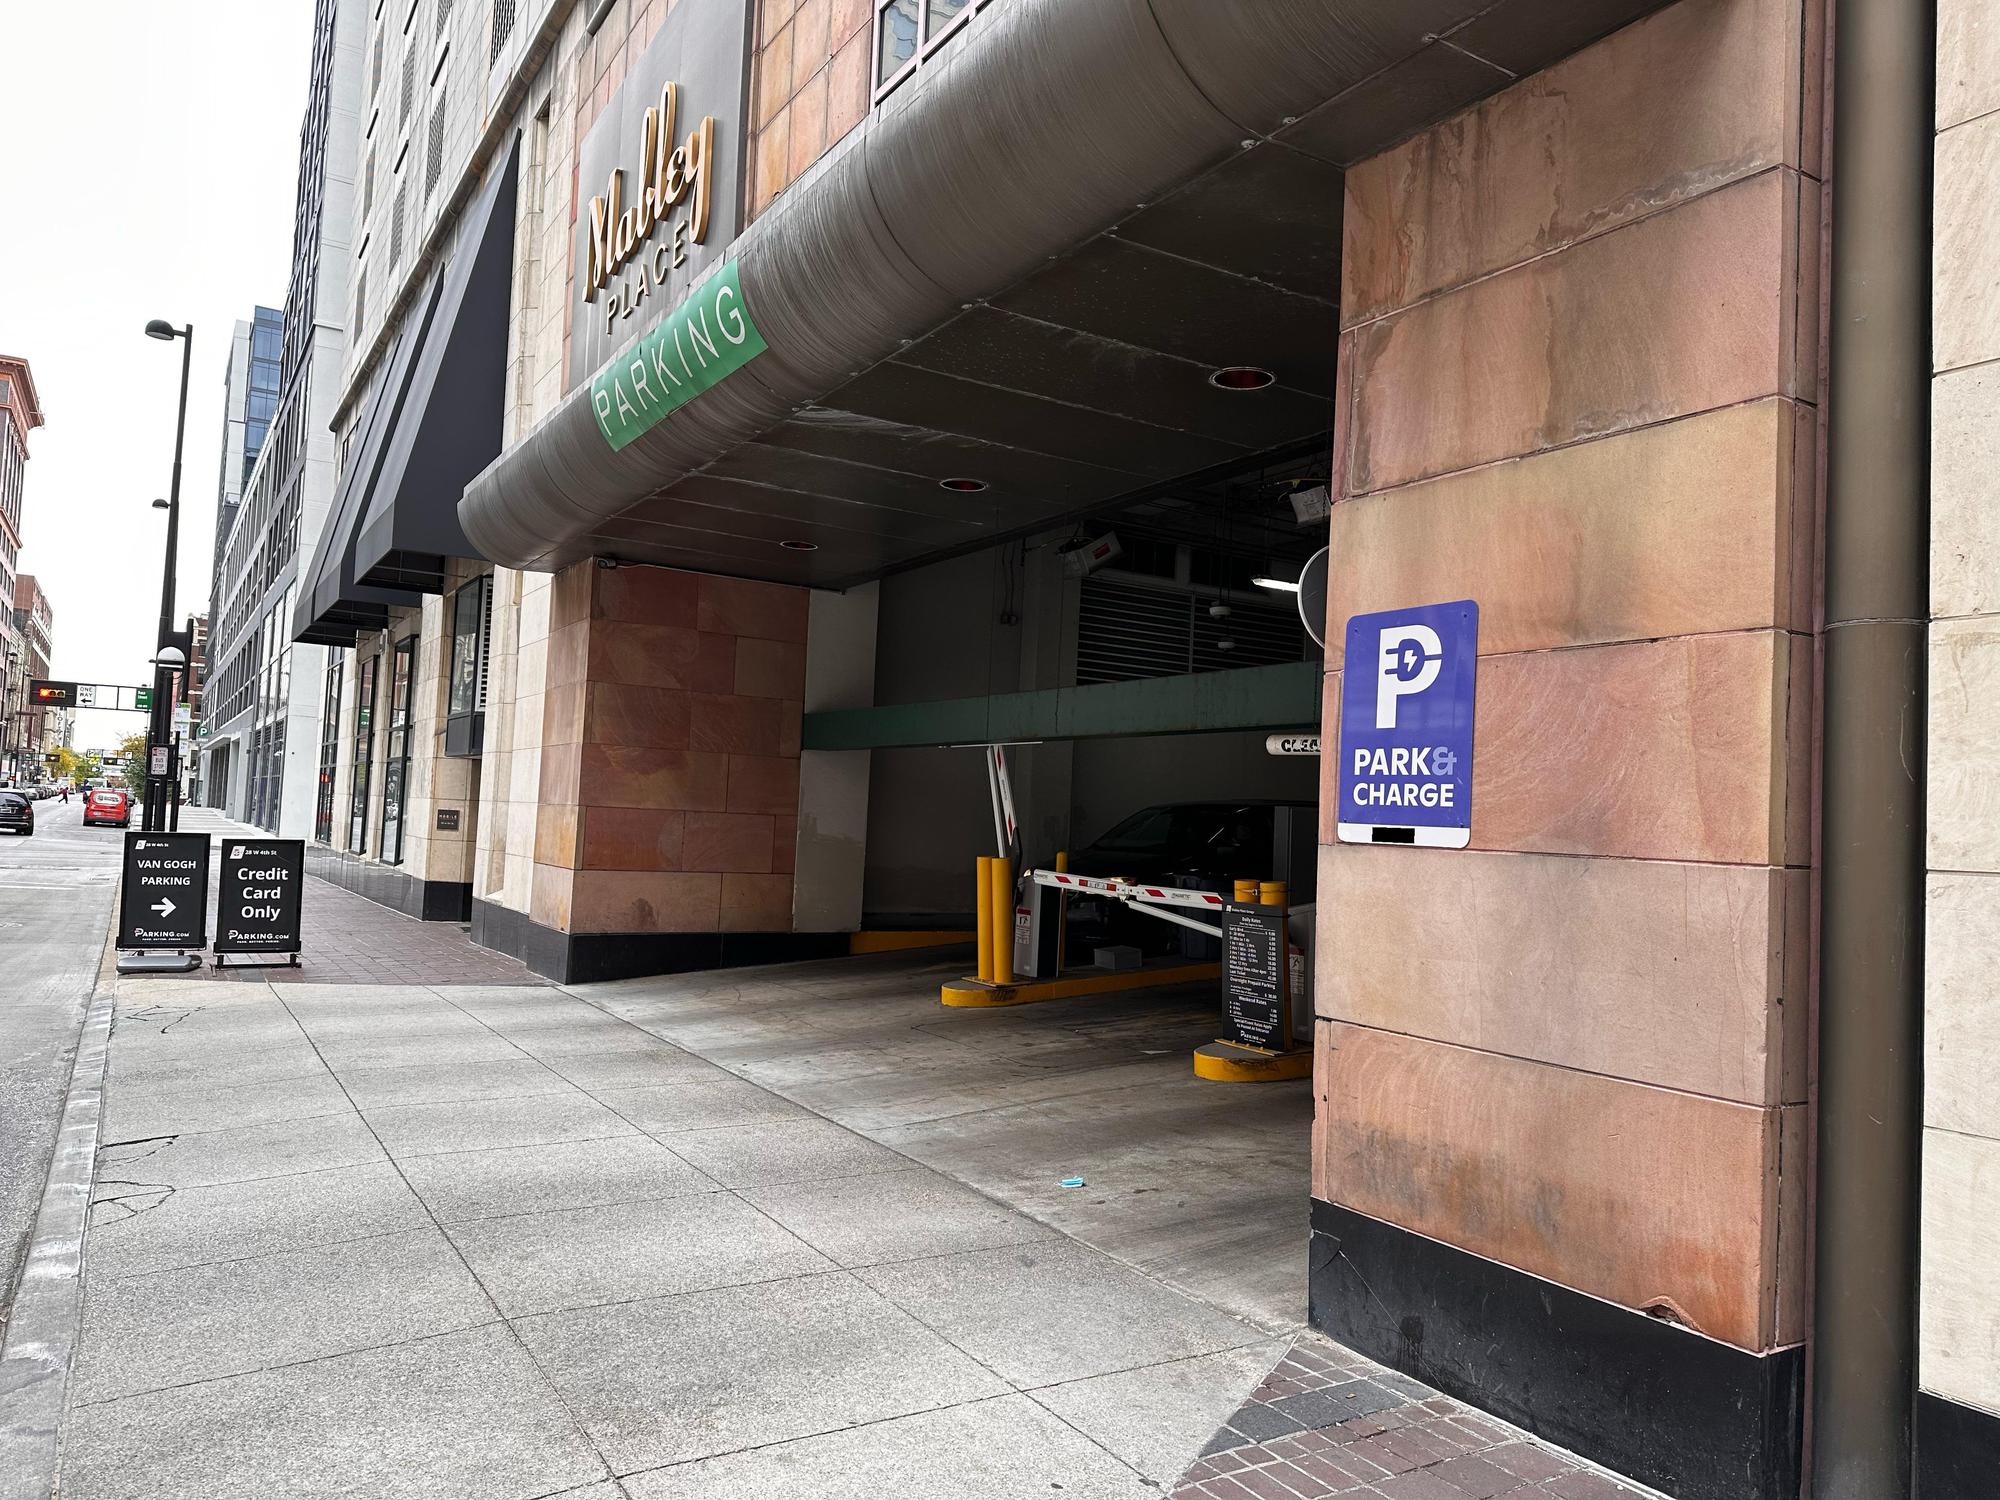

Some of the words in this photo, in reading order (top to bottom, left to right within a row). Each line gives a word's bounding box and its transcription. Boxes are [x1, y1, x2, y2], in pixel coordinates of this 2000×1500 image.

[582, 81, 714, 303] Mabley
[606, 220, 687, 335] PLACE
[595, 285, 747, 437] PARKING
[1281, 739, 1321, 752] CLEA
[1354, 746, 1457, 776] PARK&
[1353, 783, 1455, 808] CHARGE
[138, 860, 161, 869] VAN
[164, 860, 196, 869] GOGH
[142, 877, 190, 885] PARKING
[238, 868, 288, 880] Credit
[243, 886, 281, 899] Card
[242, 906, 280, 921] Only
